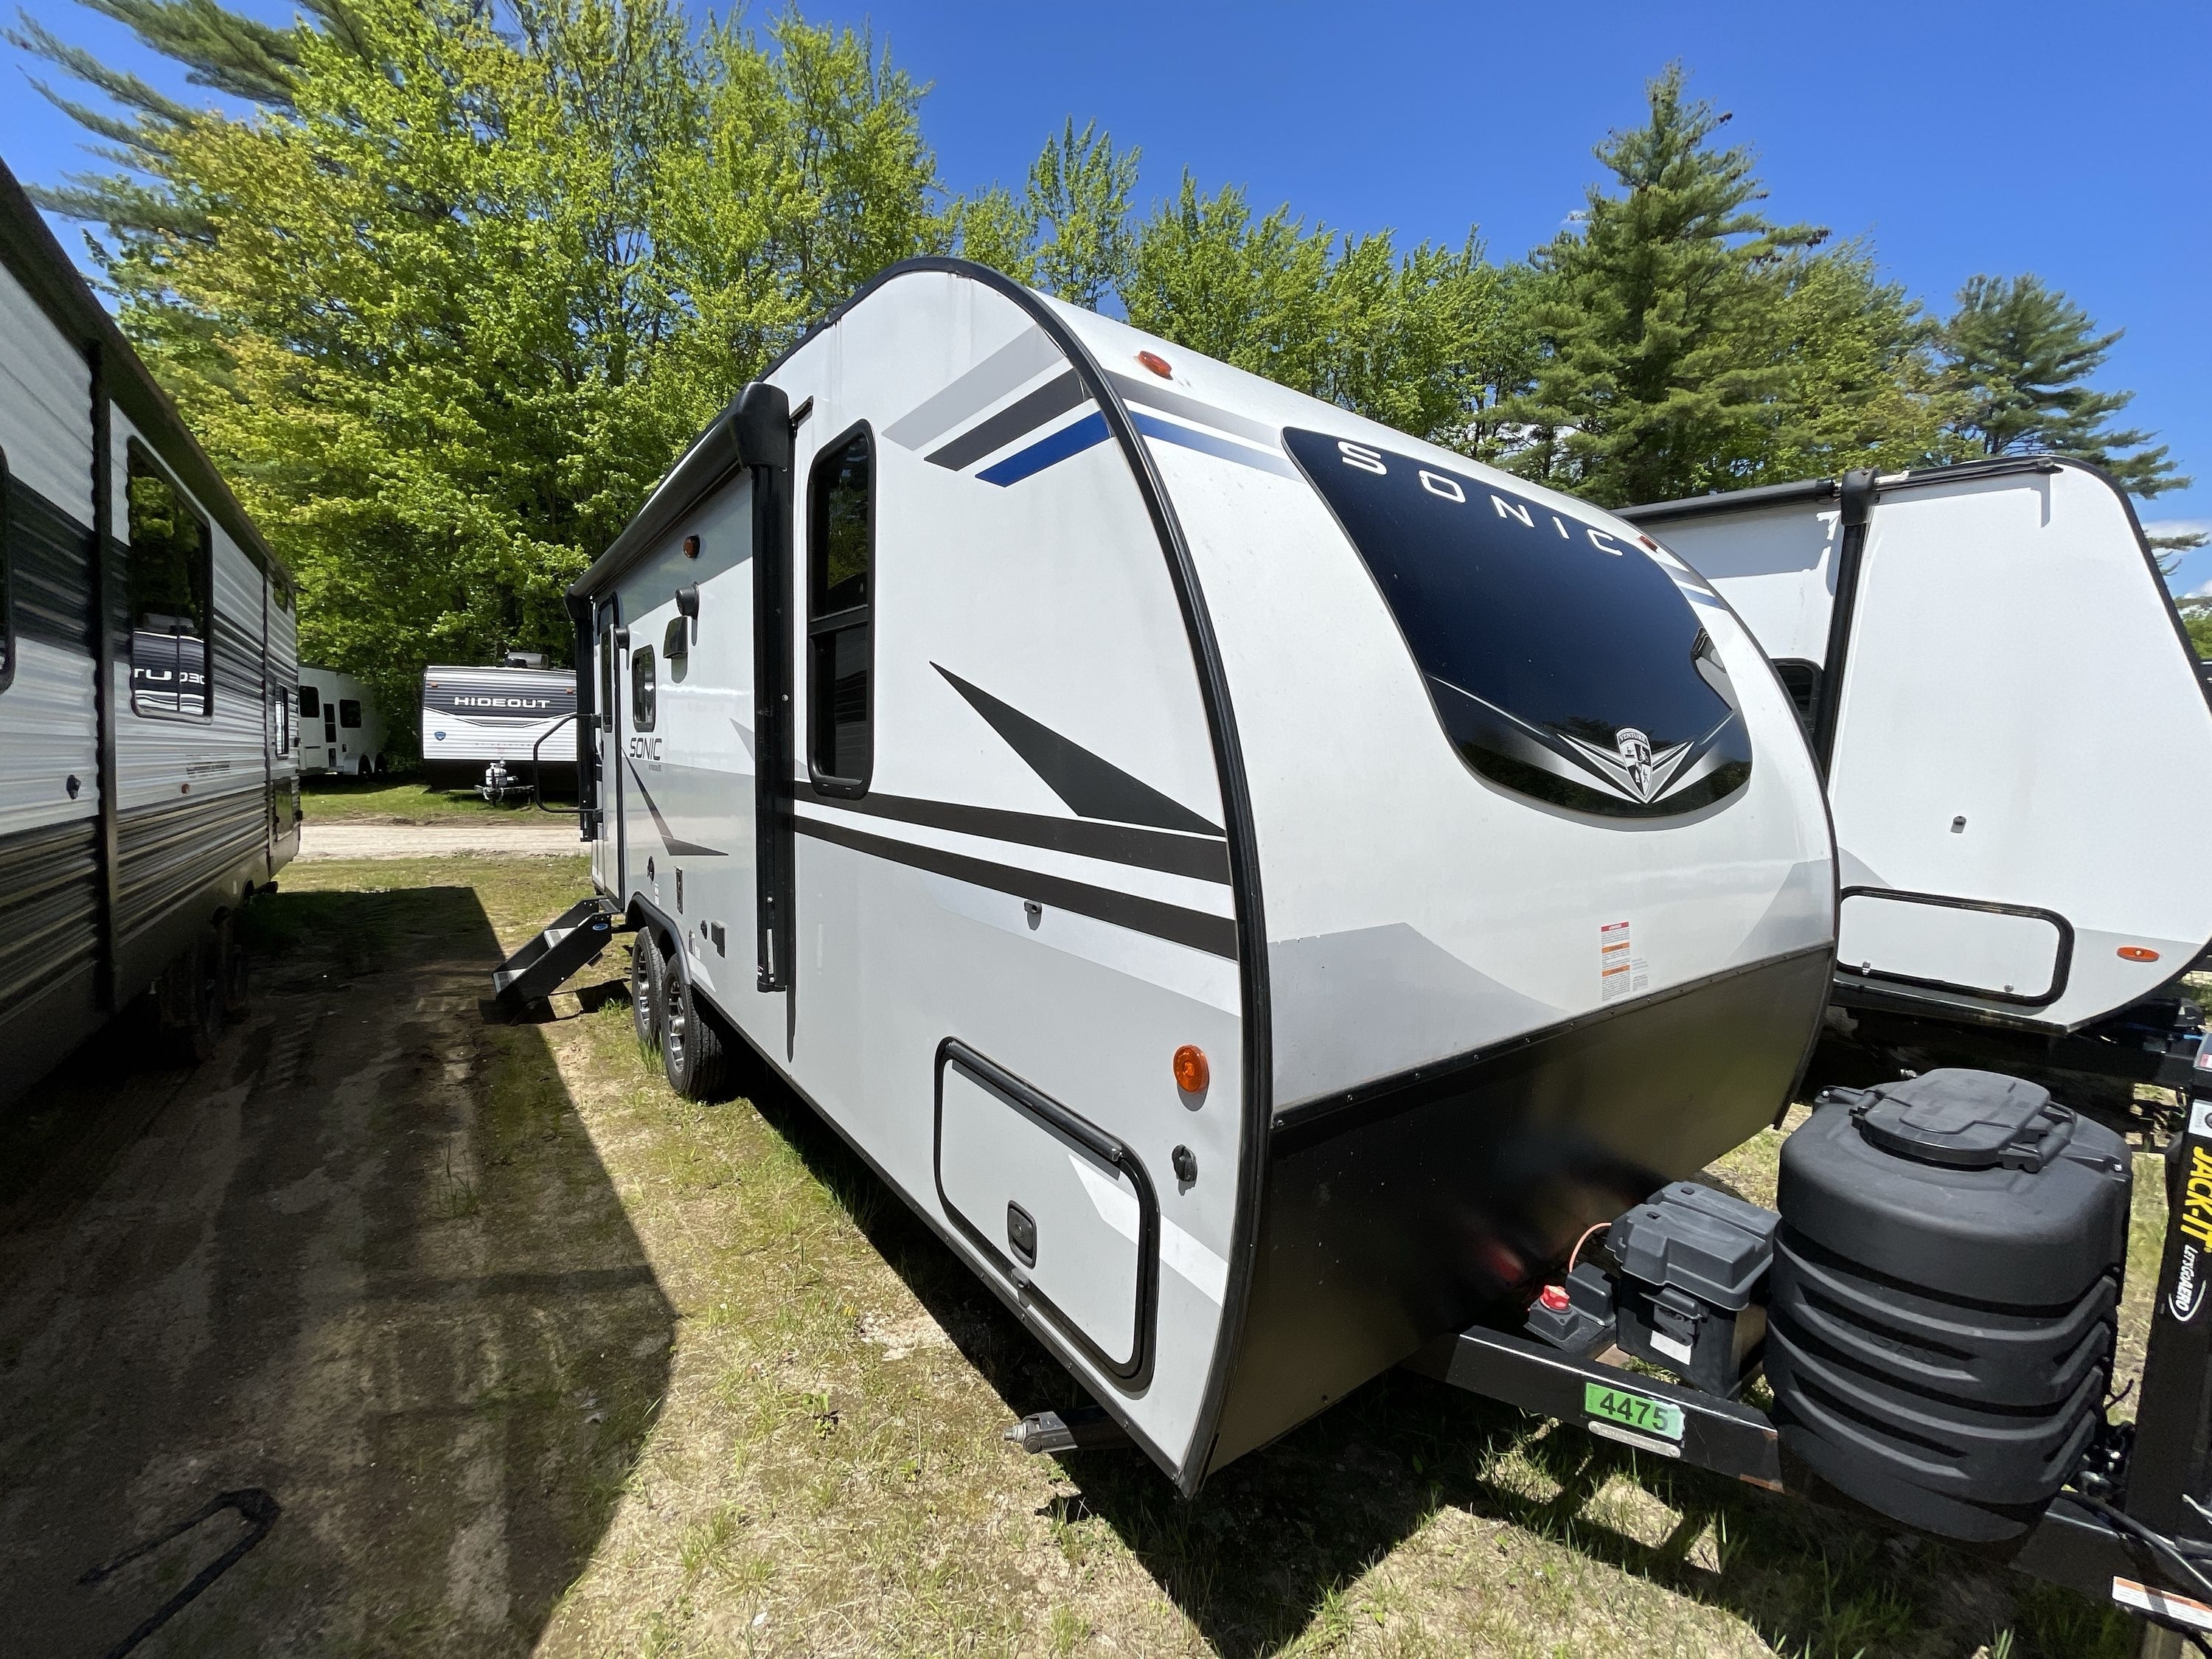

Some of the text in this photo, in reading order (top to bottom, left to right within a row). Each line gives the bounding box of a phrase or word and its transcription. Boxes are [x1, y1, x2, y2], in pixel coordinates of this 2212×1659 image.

[1338, 441, 1623, 556] SONIC
[453, 696, 551, 709] HIDEOUT
[629, 737, 662, 761] SONIC
[1599, 1392, 1669, 1431] 4475
